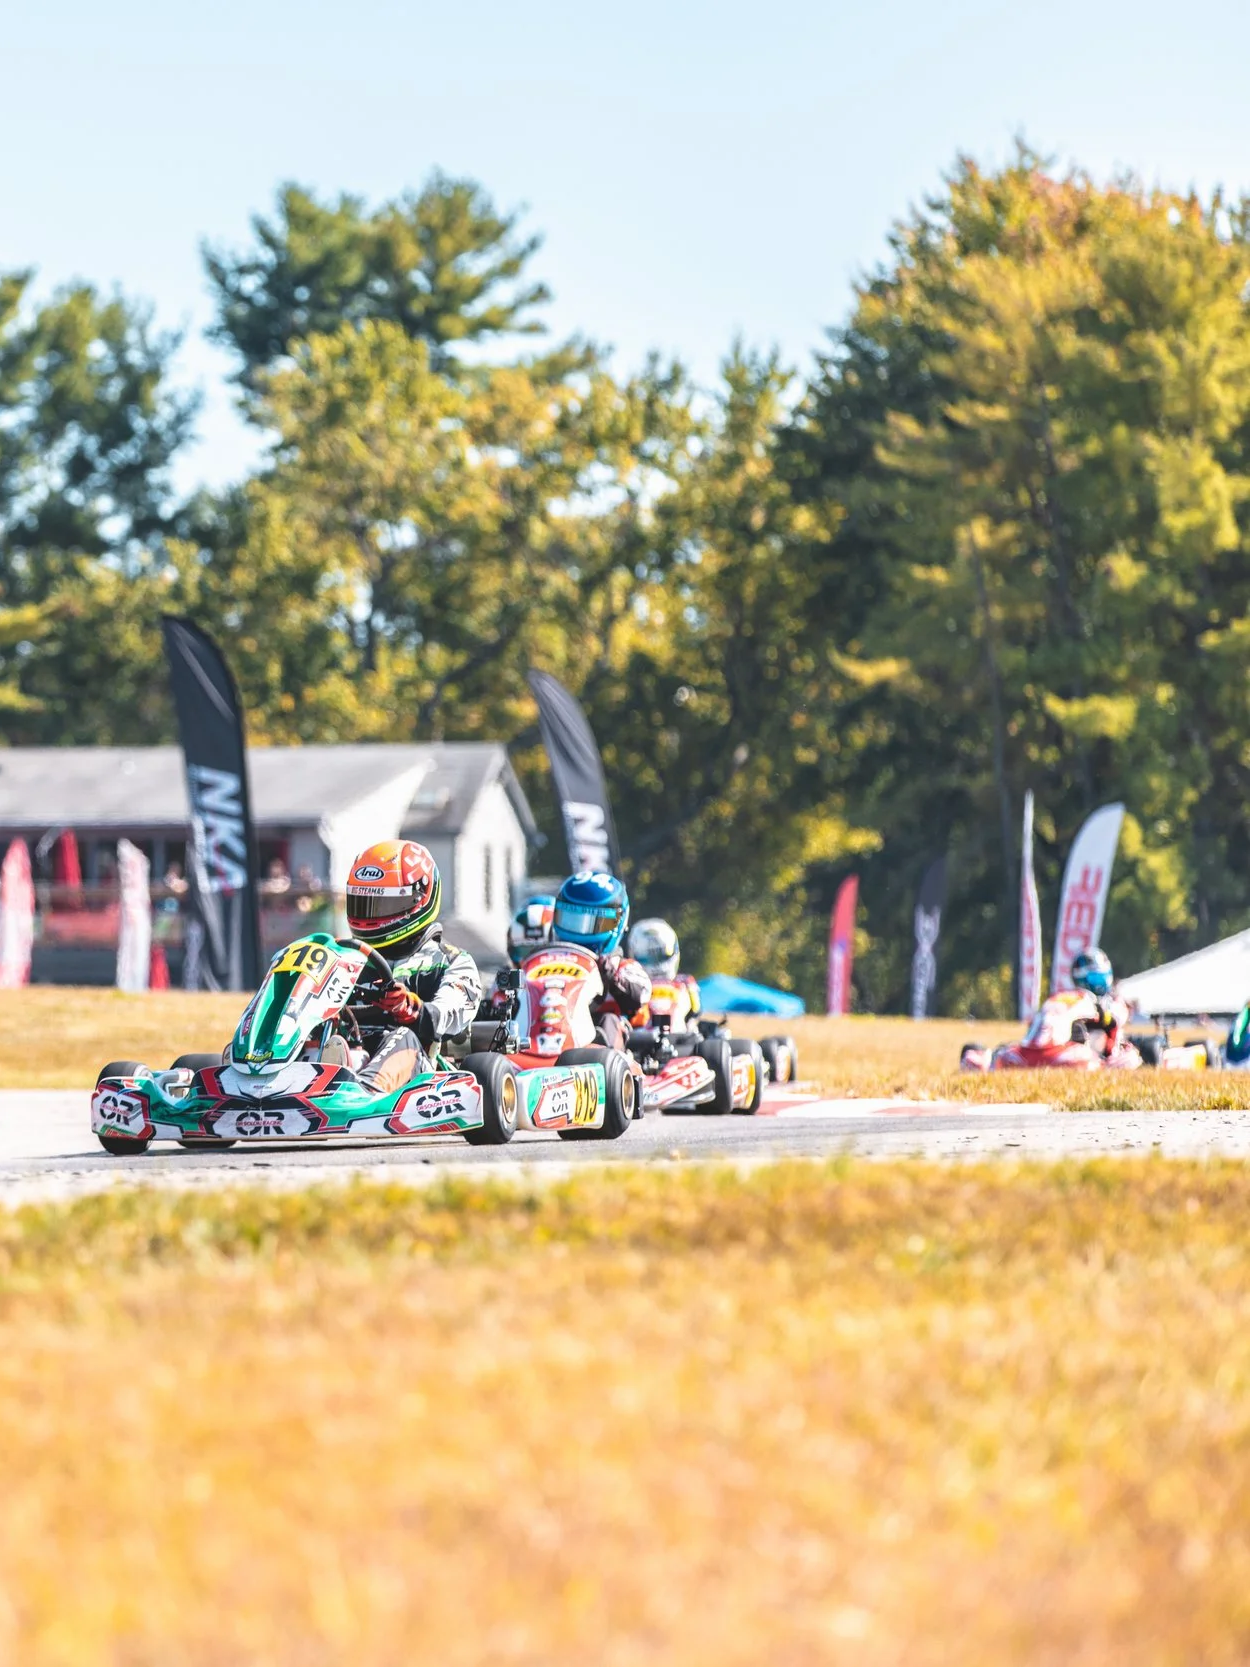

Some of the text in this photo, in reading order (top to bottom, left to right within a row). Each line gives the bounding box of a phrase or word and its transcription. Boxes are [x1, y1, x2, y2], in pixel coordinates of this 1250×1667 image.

[192, 765, 249, 894] NKA
[562, 801, 612, 876] NK
[358, 867, 381, 877] Arai
[100, 1095, 134, 1126] OR
[416, 1089, 467, 1118] OR
[235, 1112, 286, 1136] OR
